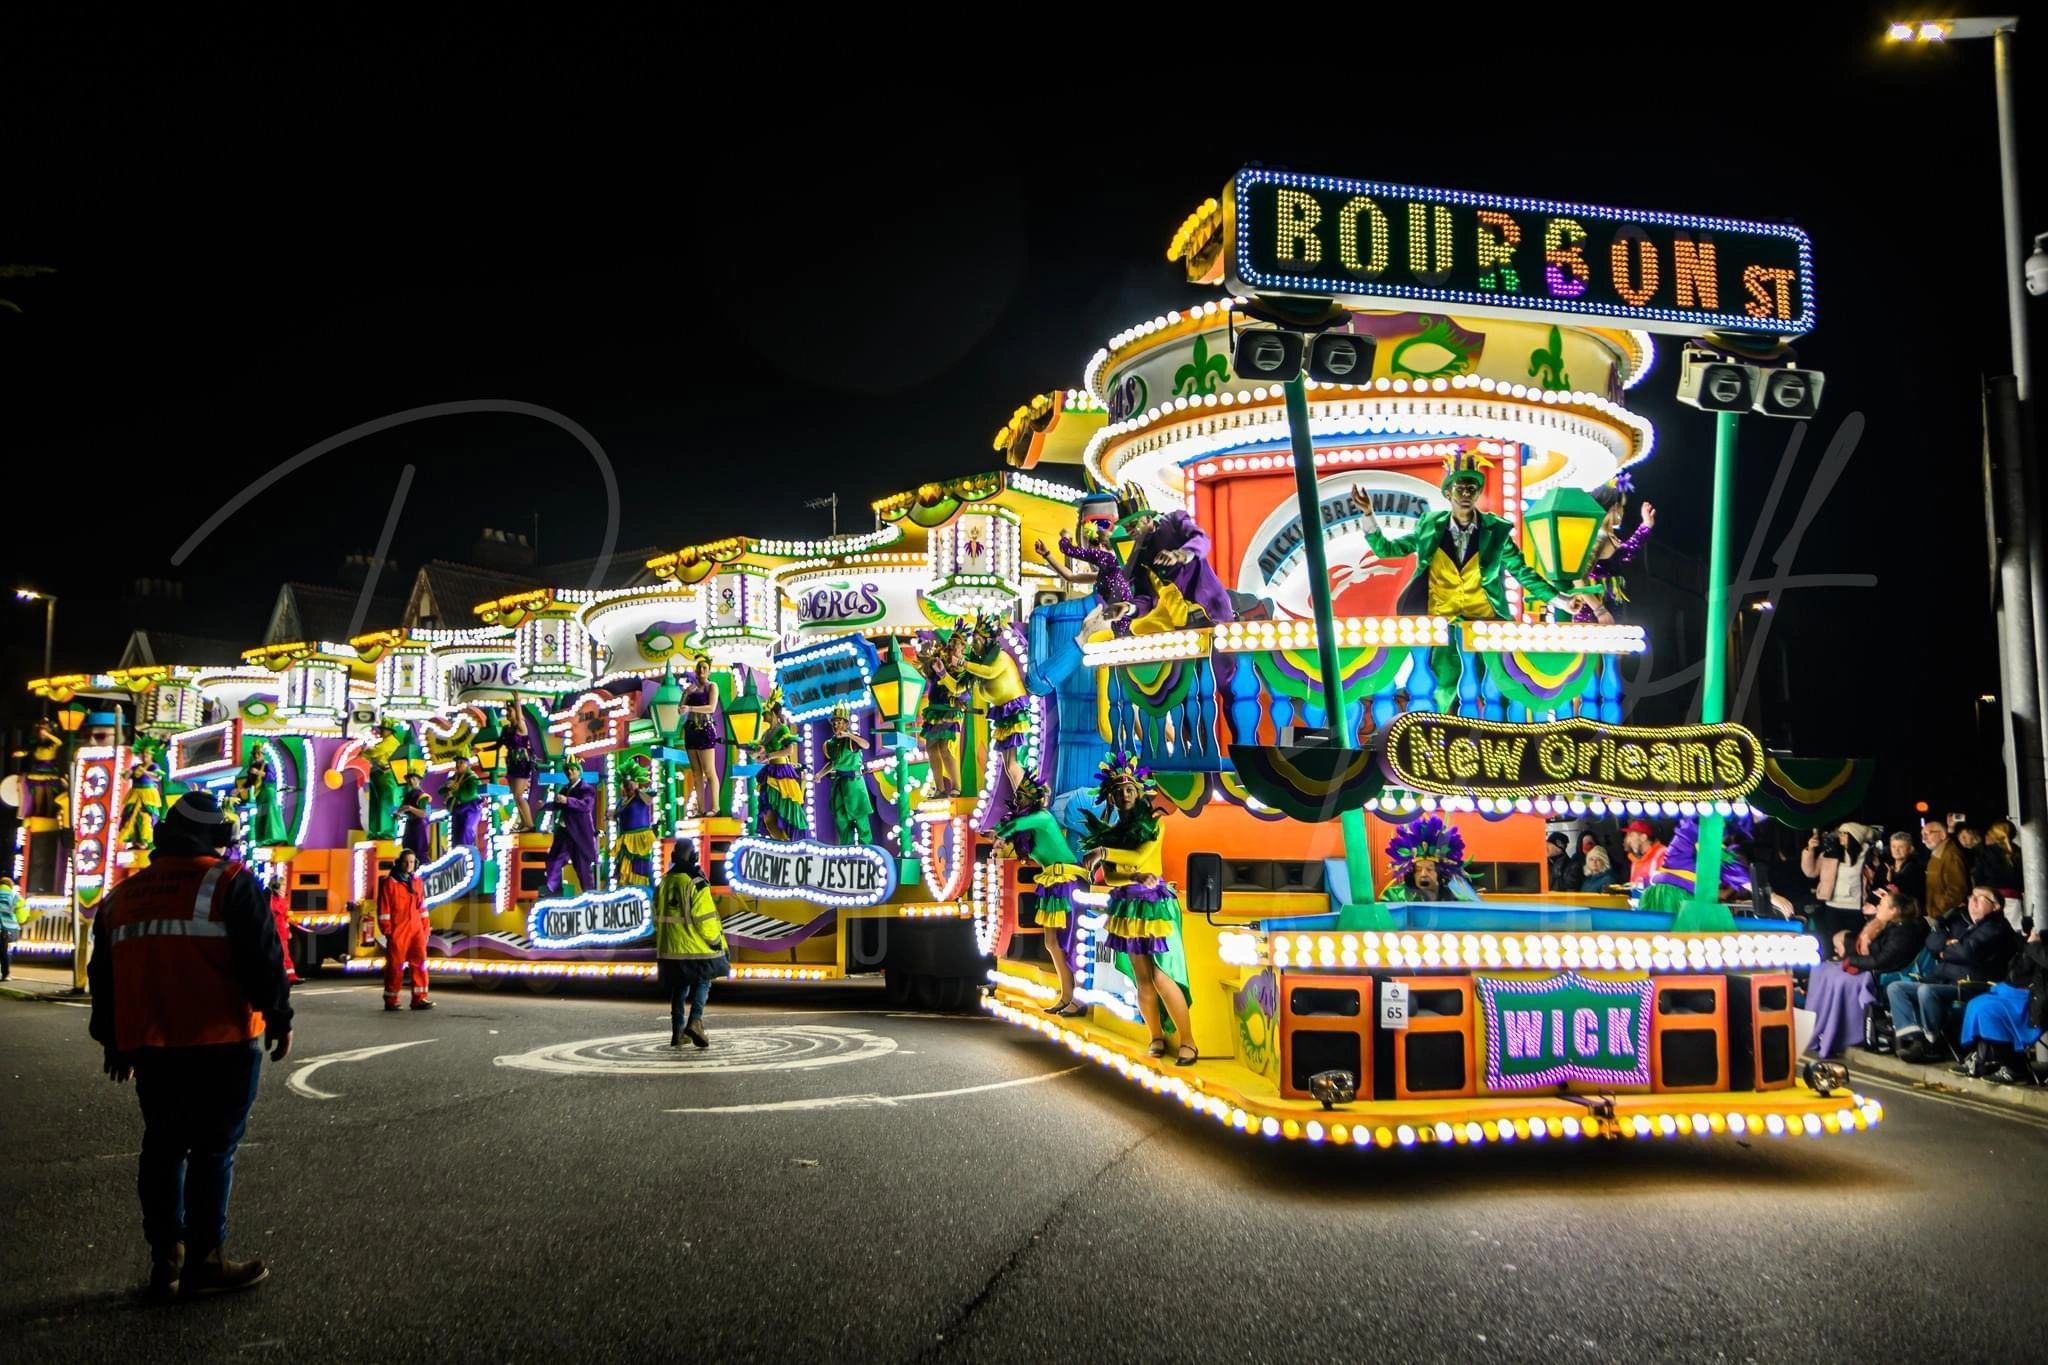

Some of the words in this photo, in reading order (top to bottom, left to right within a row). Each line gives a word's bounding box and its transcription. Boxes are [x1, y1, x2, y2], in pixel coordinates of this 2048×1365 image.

[1277, 189, 1719, 308] BOURBON
[1743, 264, 1796, 320] ST
[1259, 521, 1304, 572] DICKI
[1321, 493, 1428, 524] BRENAN'S
[1408, 726, 1527, 781] New
[1539, 734, 1745, 784] Orleans
[744, 852, 791, 887] KREWE
[795, 856, 813, 886] OF
[817, 858, 882, 891] JESTER
[547, 907, 582, 937] KREWE
[585, 905, 599, 931] OF
[1387, 1006, 1402, 1019] 65
[1503, 1008, 1635, 1058] WICK
